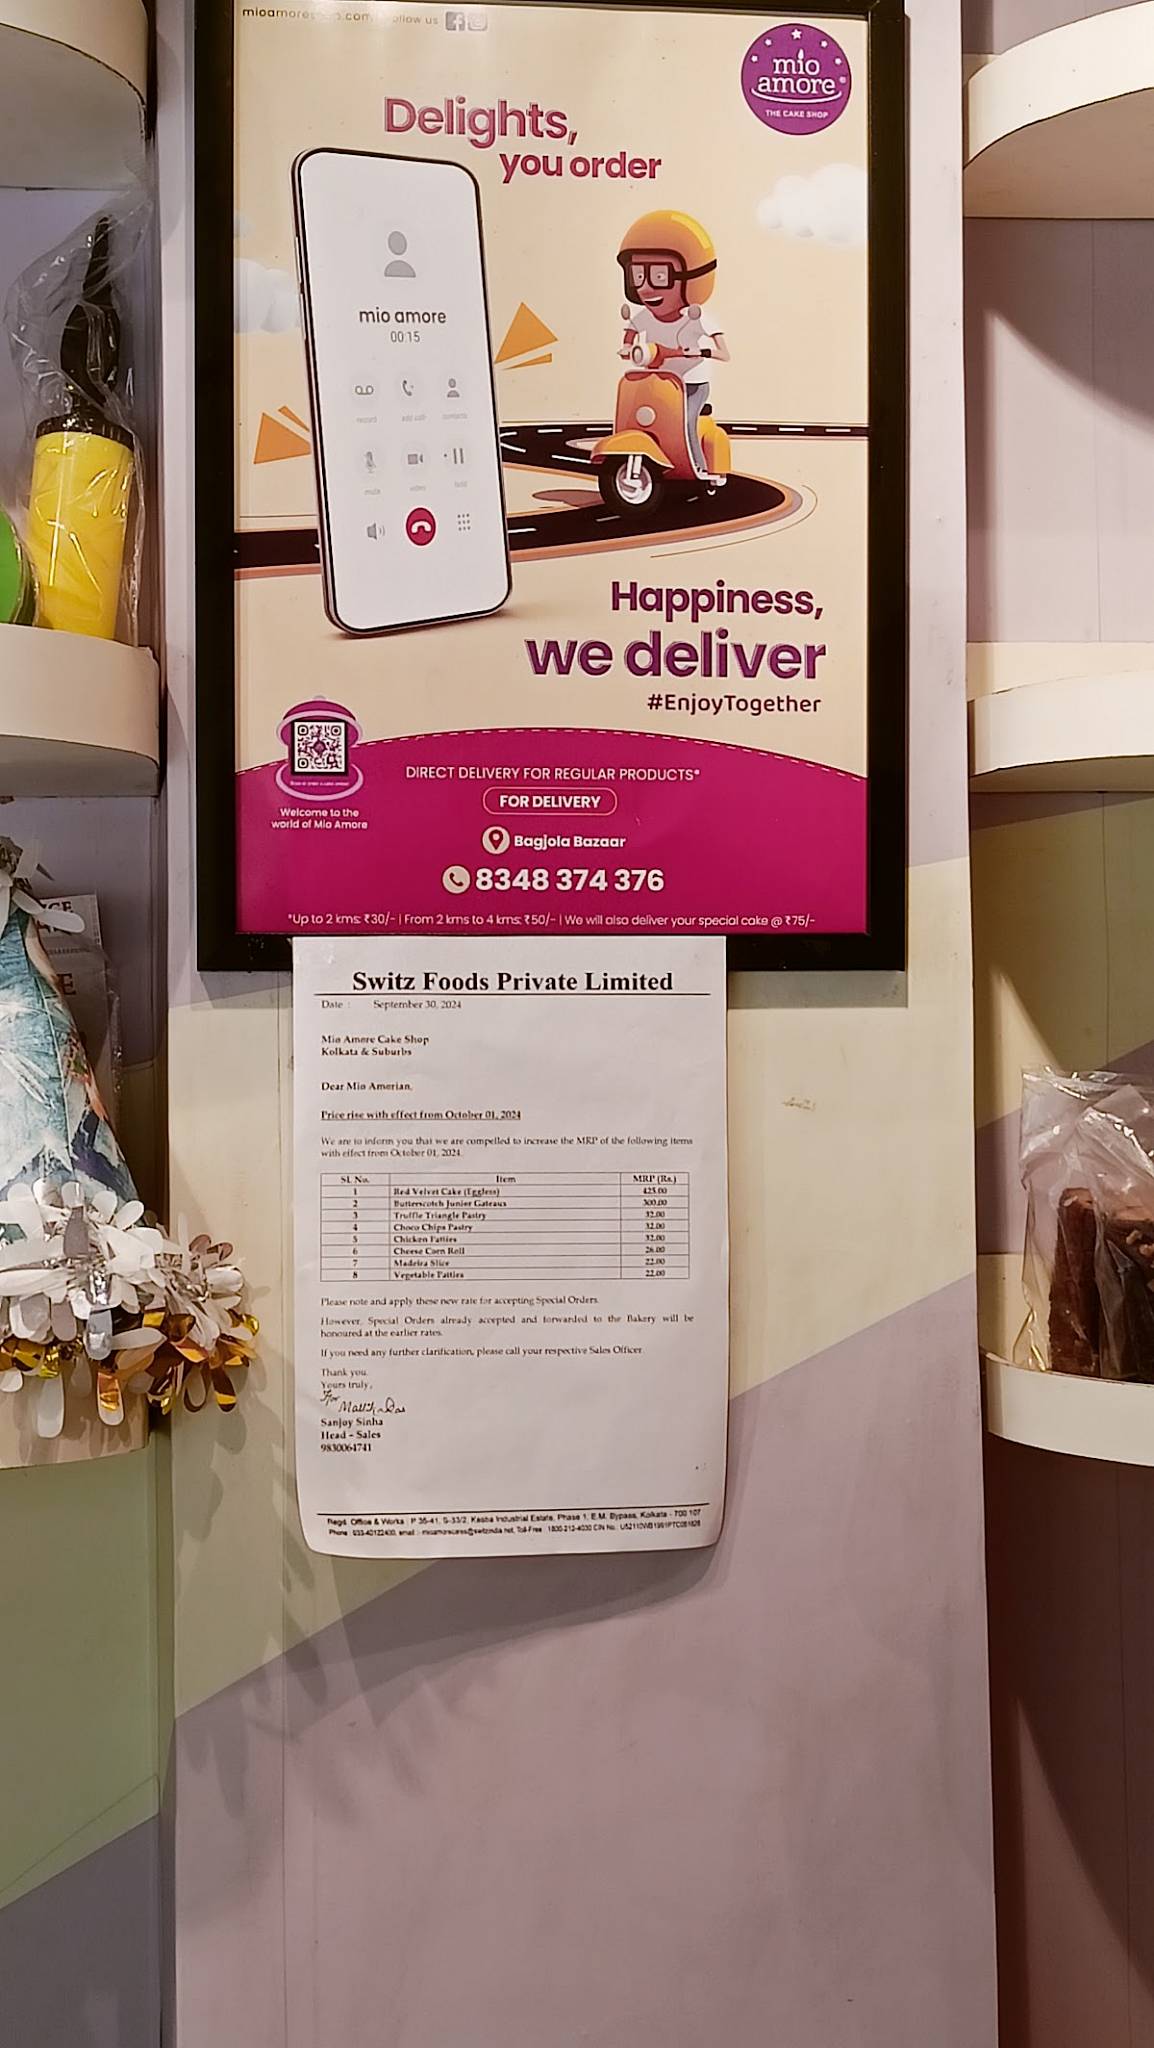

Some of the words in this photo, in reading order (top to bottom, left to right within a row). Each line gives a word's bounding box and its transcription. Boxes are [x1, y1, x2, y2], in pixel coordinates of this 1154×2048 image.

[425, 16, 438, 24] us
[773, 53, 820, 75] mio
[758, 76, 836, 94] amore
[384, 96, 579, 149] Delights,
[499, 150, 563, 184] you
[569, 149, 663, 180] order
[359, 307, 390, 323] mio
[394, 310, 447, 324] amore
[611, 579, 824, 625] Happiness,
[525, 637, 614, 677] we
[624, 627, 827, 682] deliver
[646, 692, 822, 716] #EnjoyTogether
[406, 766, 454, 780] DIRECT
[458, 766, 520, 780] DELIVERY
[523, 766, 551, 780] FOR
[554, 766, 616, 781] REGULAR
[499, 794, 528, 809] FOR
[531, 794, 601, 809] DELIVERY
[280, 808, 327, 817] Welcome
[330, 809, 341, 817] to
[343, 808, 359, 817] the
[271, 820, 299, 829] world
[302, 820, 311, 829] of
[314, 820, 332, 829] Mio
[335, 821, 368, 829] Amore
[514, 834, 570, 852] Bagjola
[573, 834, 626, 848] Bazaar
[475, 868, 550, 893] 8348
[556, 868, 608, 893] 374
[614, 868, 665, 893] 376
[311, 914, 323, 924] to
[326, 914, 333, 924] 2
[364, 914, 395, 925] ₹30/-
[405, 914, 433, 925] From
[437, 914, 444, 924] 2
[446, 914, 469, 925] kms
[472, 915, 484, 925] to
[486, 915, 494, 925] 4
[524, 913, 556, 926] ₹50/-
[564, 915, 583, 925] We
[586, 915, 603, 925] will
[605, 915, 629, 925] also
[631, 915, 667, 926] deliver
[671, 917, 696, 928] your
[699, 915, 739, 928] special
[741, 915, 768, 926] cake
[771, 917, 782, 928] @
[353, 971, 415, 991] Switz
[423, 972, 489, 991] Foods
[498, 972, 577, 991] Private
[585, 972, 673, 991] Limited
[321, 1001, 343, 1009] Date
[373, 1000, 423, 1011] September
[441, 1001, 461, 1009] 2024
[321, 1035, 341, 1043] Mio
[343, 1035, 375, 1043] Amore
[378, 1035, 401, 1043] Cake
[405, 1035, 429, 1045] Shop
[321, 1047, 358, 1055] Kolkata
[372, 1047, 412, 1055] Suburbs
[321, 1082, 344, 1091] Dear
[347, 1082, 366, 1091] Mio
[321, 1111, 345, 1120] Price
[347, 1111, 364, 1120] rise
[367, 1111, 388, 1120] with
[391, 1111, 417, 1120] effect
[419, 1111, 443, 1120] from
[445, 1111, 483, 1120] October
[501, 1111, 521, 1120] 2024
[321, 1137, 336, 1145] We
[364, 1137, 394, 1145] inform
[396, 1139, 413, 1147] you
[415, 1137, 433, 1145] that
[466, 1137, 510, 1147] compelled
[524, 1137, 558, 1145] increase
[561, 1137, 574, 1145] the
[577, 1137, 598, 1145] MRP
[600, 1137, 608, 1145] of
[611, 1137, 624, 1145] the
[627, 1137, 668, 1147] following
[670, 1137, 692, 1145] items
[496, 1175, 516, 1183] Item
[633, 1175, 655, 1183] MRP
[446, 1200, 472, 1209] Junior
[426, 1212, 459, 1221] Triangle
[462, 1212, 486, 1220] Pastry
[422, 1224, 446, 1232] Chips
[448, 1224, 473, 1232] Pastry
[353, 1271, 358, 1279] 8
[394, 1271, 435, 1281] Vegetable
[321, 1368, 347, 1376] Thank
[320, 1381, 346, 1389] Yours
[348, 1381, 373, 1390] truly,
[320, 1418, 353, 1428] Sanjoy
[356, 1417, 383, 1426] Sinha
[321, 1431, 346, 1439] Head
[356, 1431, 381, 1439] Sales
[320, 1443, 371, 1452] 9830064741
